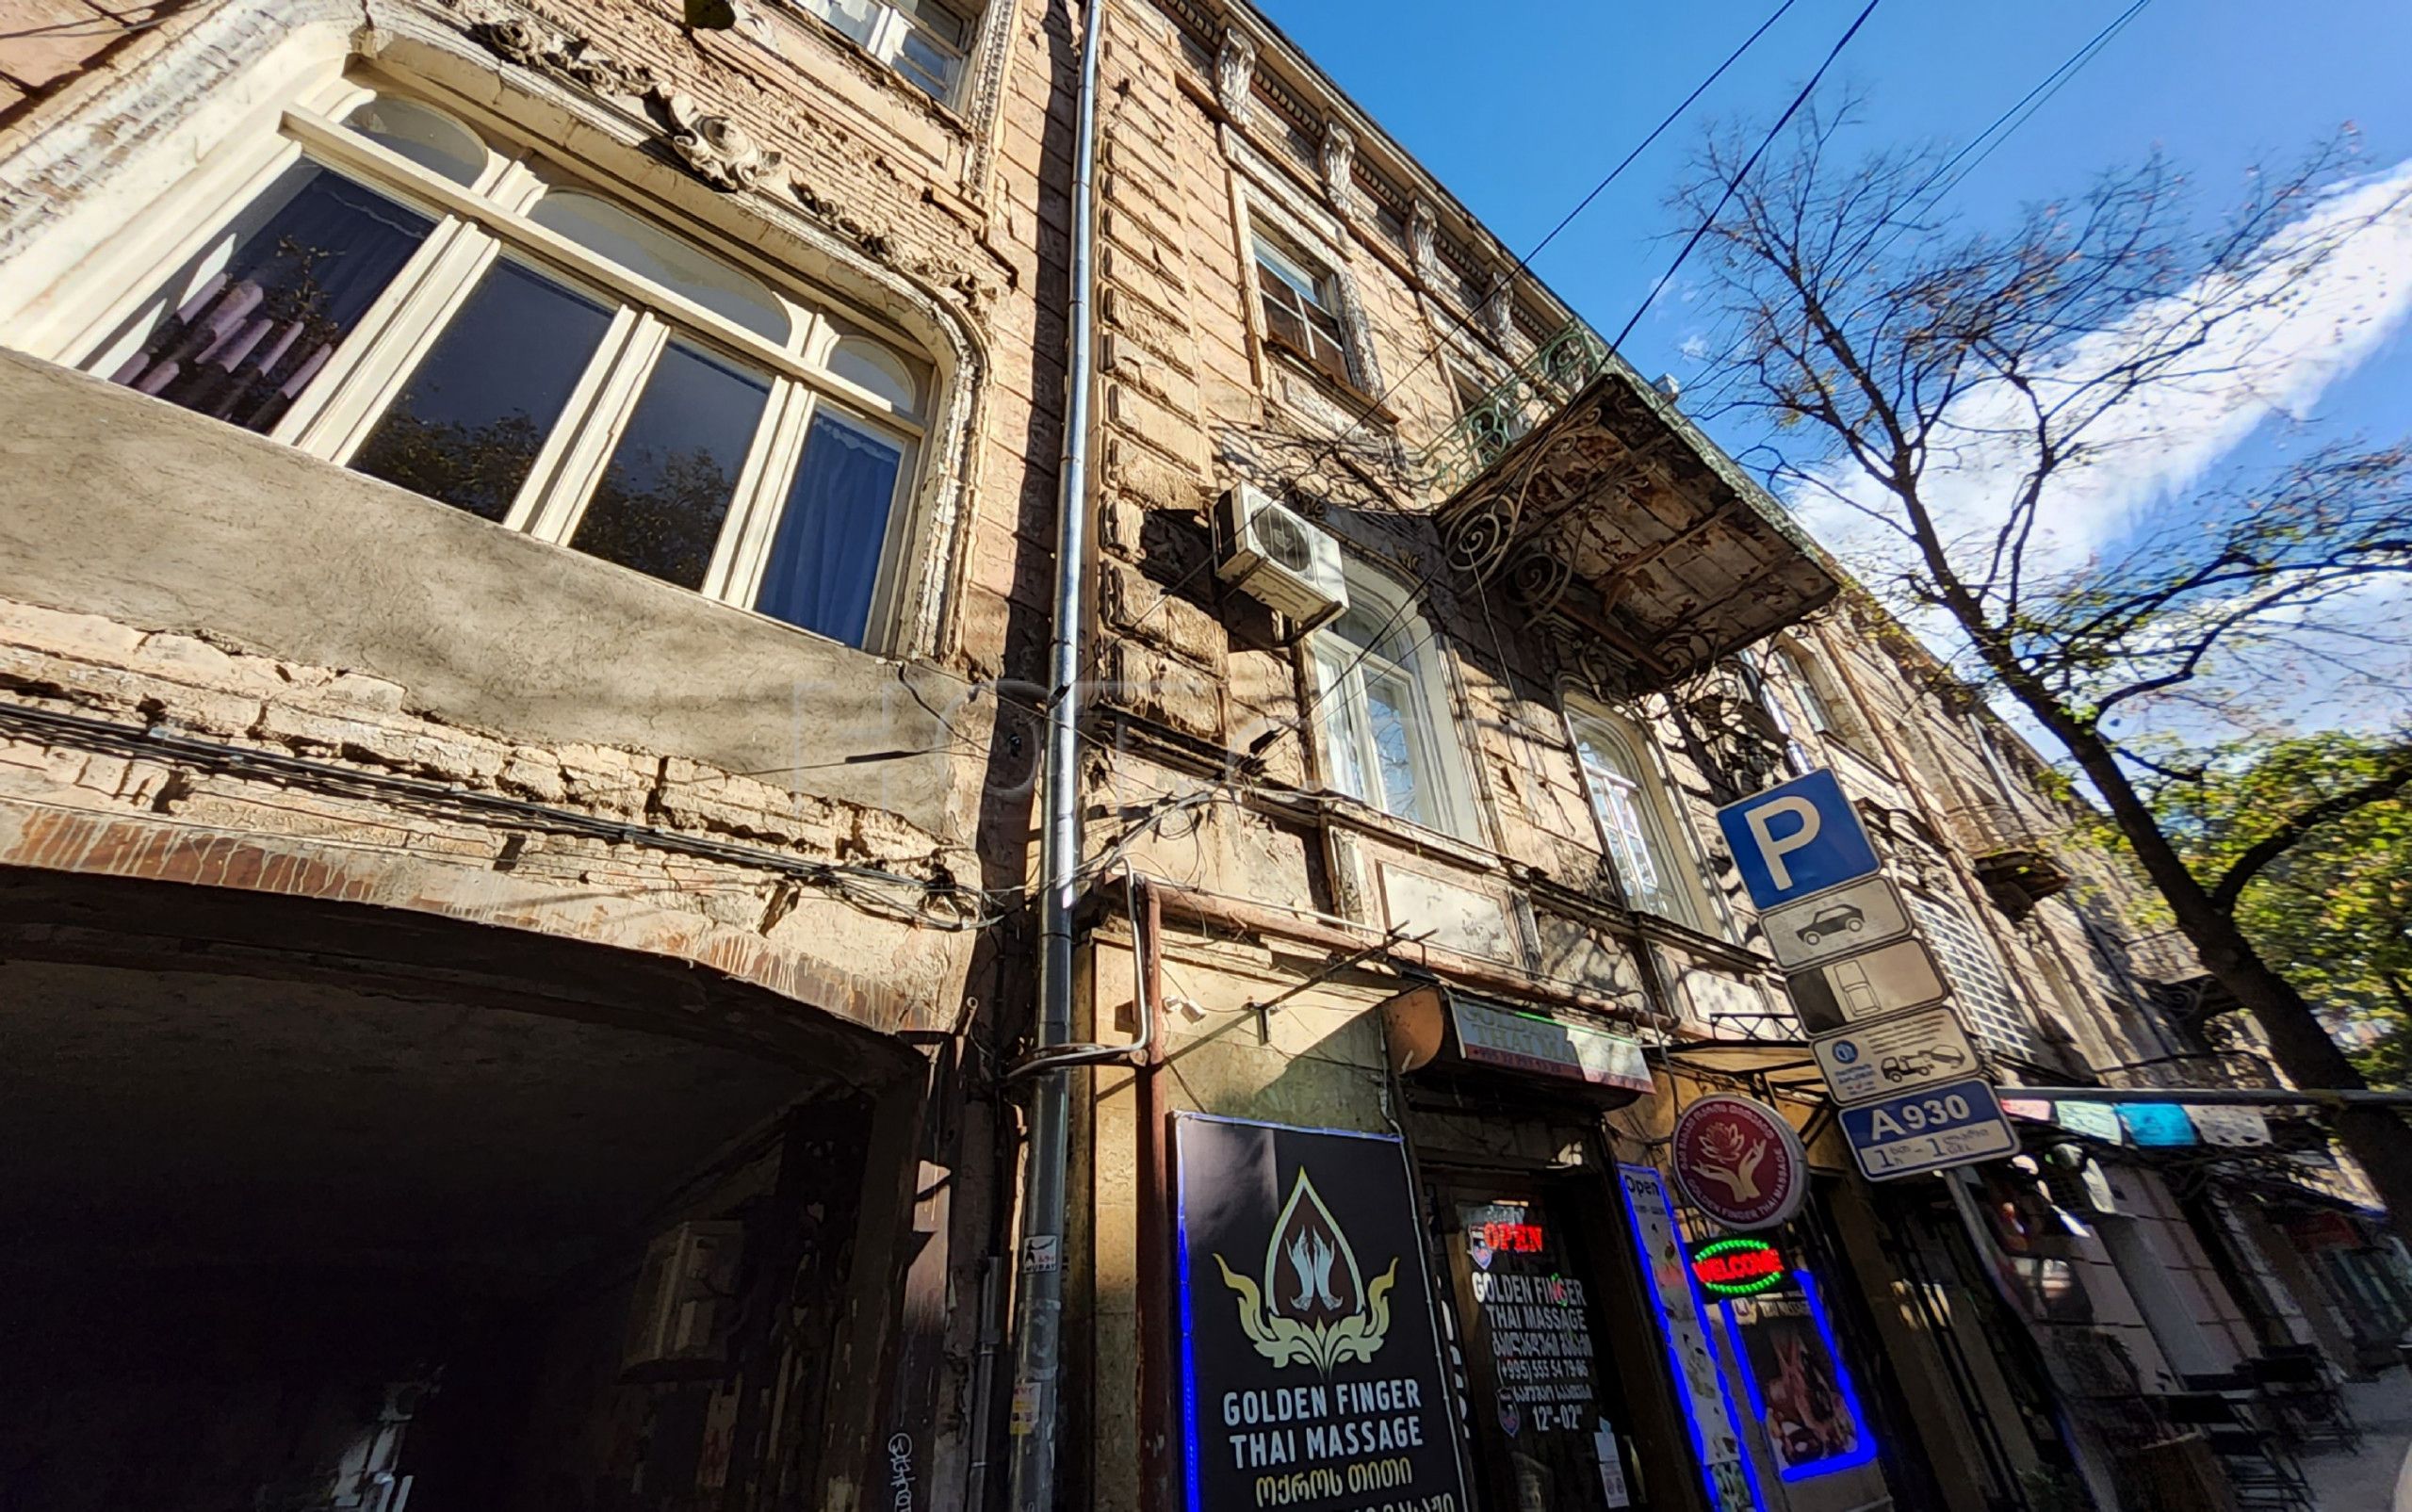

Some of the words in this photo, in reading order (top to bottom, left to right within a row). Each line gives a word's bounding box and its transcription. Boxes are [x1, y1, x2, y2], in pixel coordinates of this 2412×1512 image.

[1744, 795, 1820, 891] P
[1624, 1174, 1660, 1198] Open
[1484, 1221, 1542, 1252] OPEN
[1690, 1247, 1785, 1283] WELCOME
[1472, 1272, 1533, 1304] GOLDEN
[1534, 1276, 1588, 1307] FINGER
[1485, 1304, 1522, 1329] THAI
[1523, 1306, 1589, 1331] MASSAGE
[1496, 1358, 1532, 1385] (+995)
[1223, 1385, 1328, 1426] GOLDEN
[1335, 1378, 1422, 1416] FINGER
[1229, 1429, 1296, 1470] THAI
[1306, 1416, 1424, 1460] MASSAGE
[1255, 1467, 1344, 1508] ოქროს
[1347, 1456, 1413, 1493] თითი
